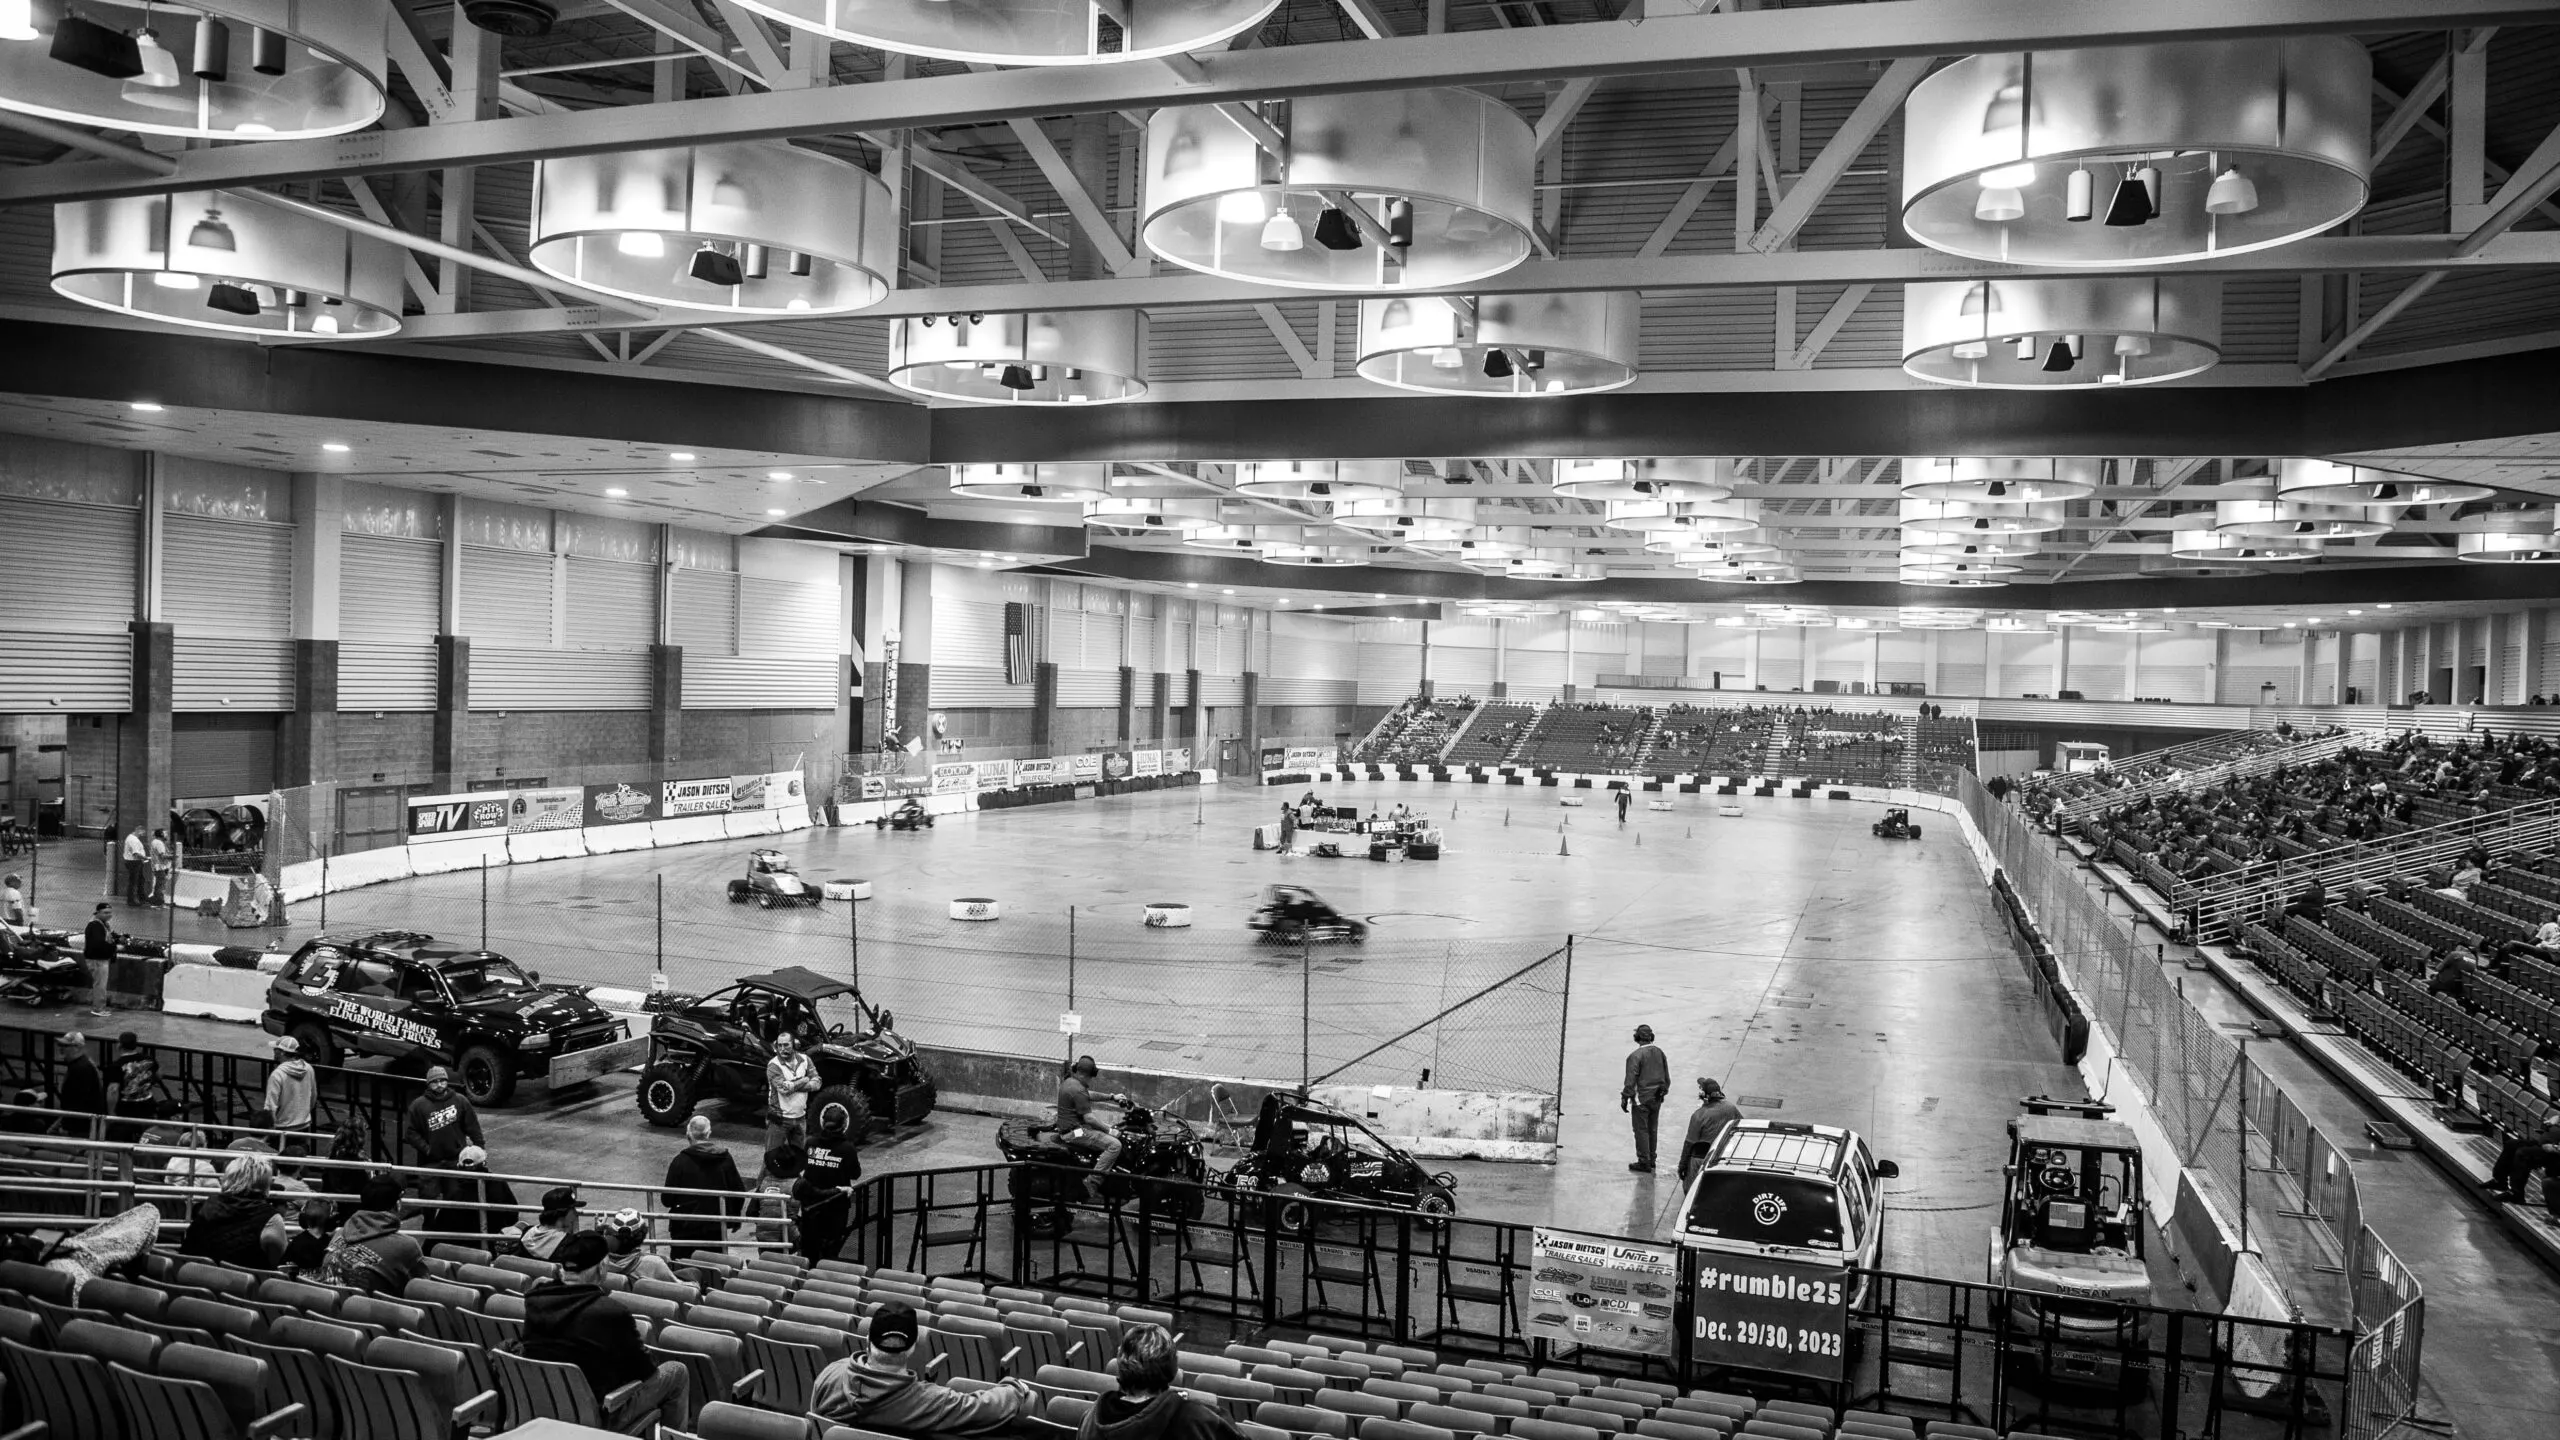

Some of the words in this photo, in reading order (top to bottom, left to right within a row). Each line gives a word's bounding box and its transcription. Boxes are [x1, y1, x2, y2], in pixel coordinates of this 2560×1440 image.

[1076, 756, 1096, 768] COE
[678, 786, 700, 797] JASON
[702, 784, 730, 796] DIETSCH
[482, 804, 497, 814] PIT
[674, 802, 704, 812] TRAILER
[705, 800, 731, 811] SALES
[418, 812, 437, 820] SPEED
[436, 803, 467, 832] TV
[480, 812, 498, 820] ROW
[338, 999, 360, 1013] THE
[360, 1005, 396, 1025] WORLD
[397, 1017, 437, 1038] FAMOUS
[329, 1006, 370, 1027] ELDORA
[371, 1018, 399, 1036] PUSH
[401, 1029, 442, 1049] TRUCKS
[1752, 1192, 1774, 1204] DIRT
[1774, 1195, 1788, 1212] LIFE
[1549, 1240, 1574, 1250] JASON
[1575, 1244, 1606, 1255] DIETSCH
[1545, 1250, 1577, 1261] TRAILER
[1577, 1255, 1605, 1266] SALES
[1613, 1247, 1660, 1263] UNITED
[1611, 1262, 1674, 1276] TRAILERS
[1534, 1288, 1561, 1297] COE
[1700, 1267, 1841, 1305] #rumble25
[2056, 1284, 2111, 1298] NISSAN
[1609, 1299, 1630, 1309] CDI
[1695, 1316, 1732, 1341] Dec.
[1738, 1321, 1792, 1354] 29/30,
[1798, 1329, 1841, 1357] 2023
